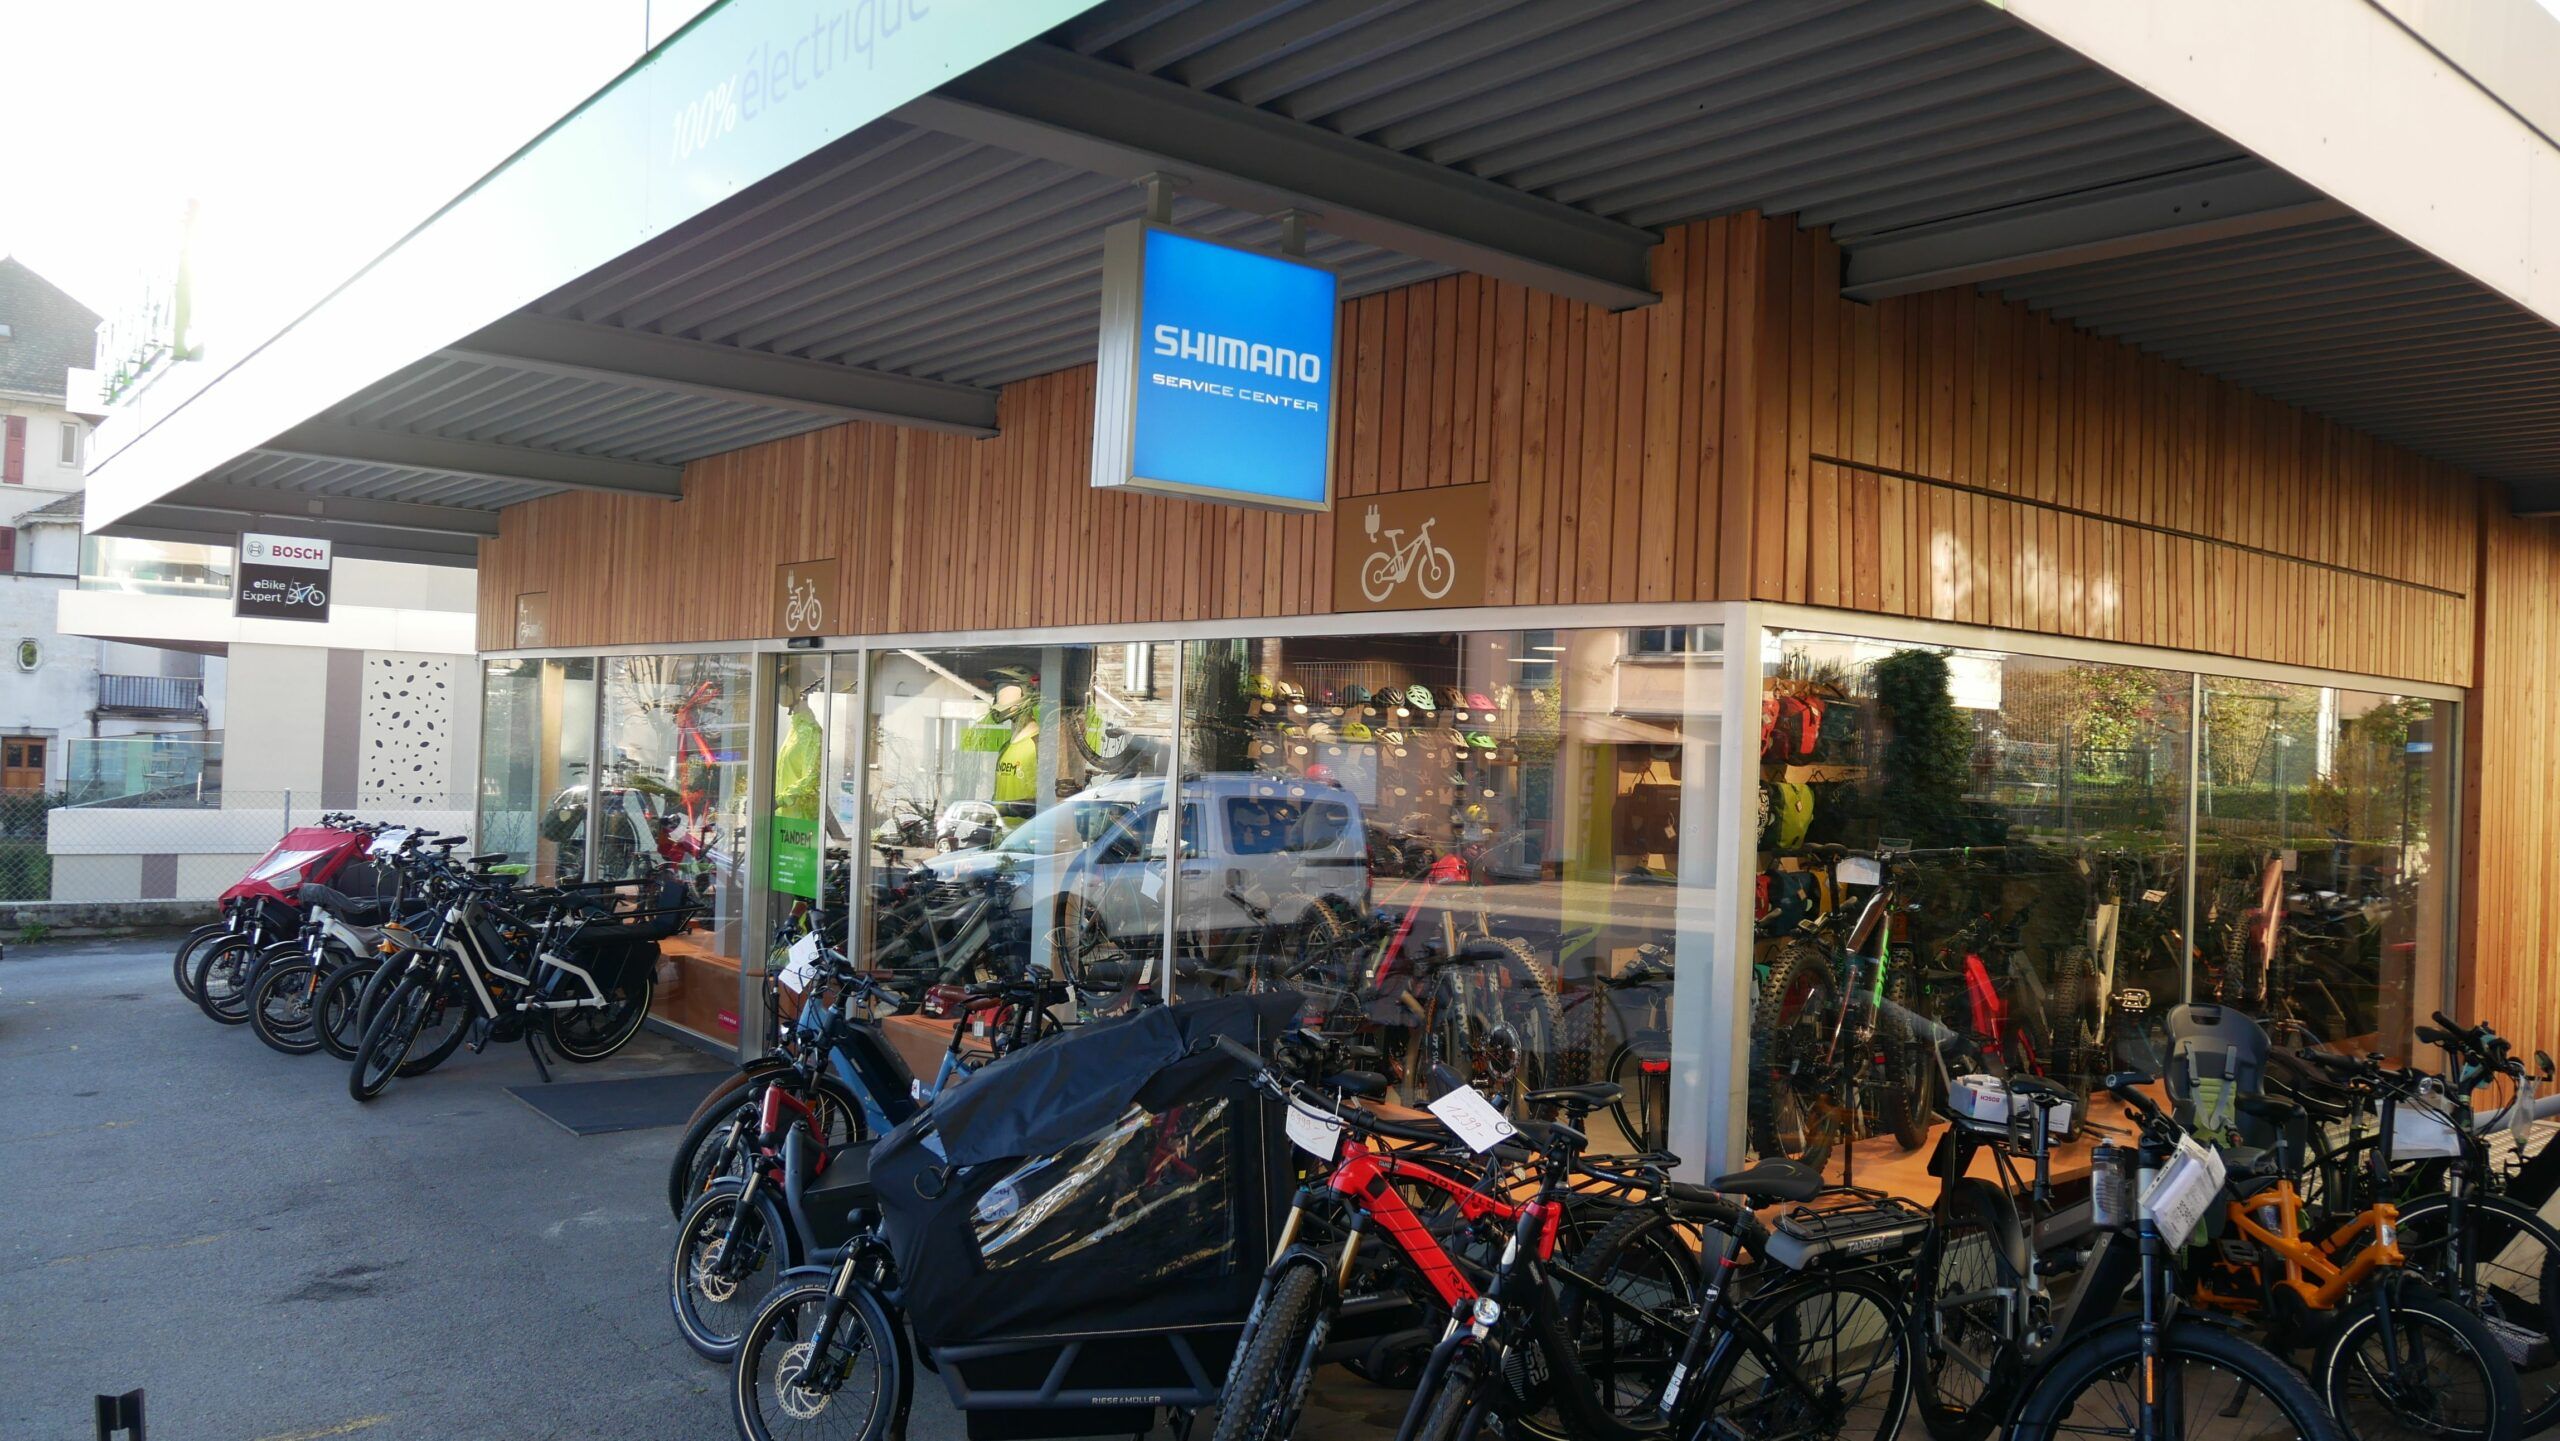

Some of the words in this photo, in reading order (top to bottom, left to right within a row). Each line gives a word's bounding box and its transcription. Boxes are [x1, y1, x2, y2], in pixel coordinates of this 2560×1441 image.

[671, 74, 737, 165] 100%
[1153, 323, 1321, 384] SHIMANO
[1152, 373, 1234, 397] SERVICE
[1238, 389, 1319, 412] CENTER
[271, 545, 324, 560] BOSCH
[253, 579, 286, 590] eBike
[242, 590, 282, 602] Expert
[780, 829, 813, 850] TANDEM
[1980, 1094, 2000, 1103] BOSCH
[1847, 1237, 1885, 1253] TANDEM
